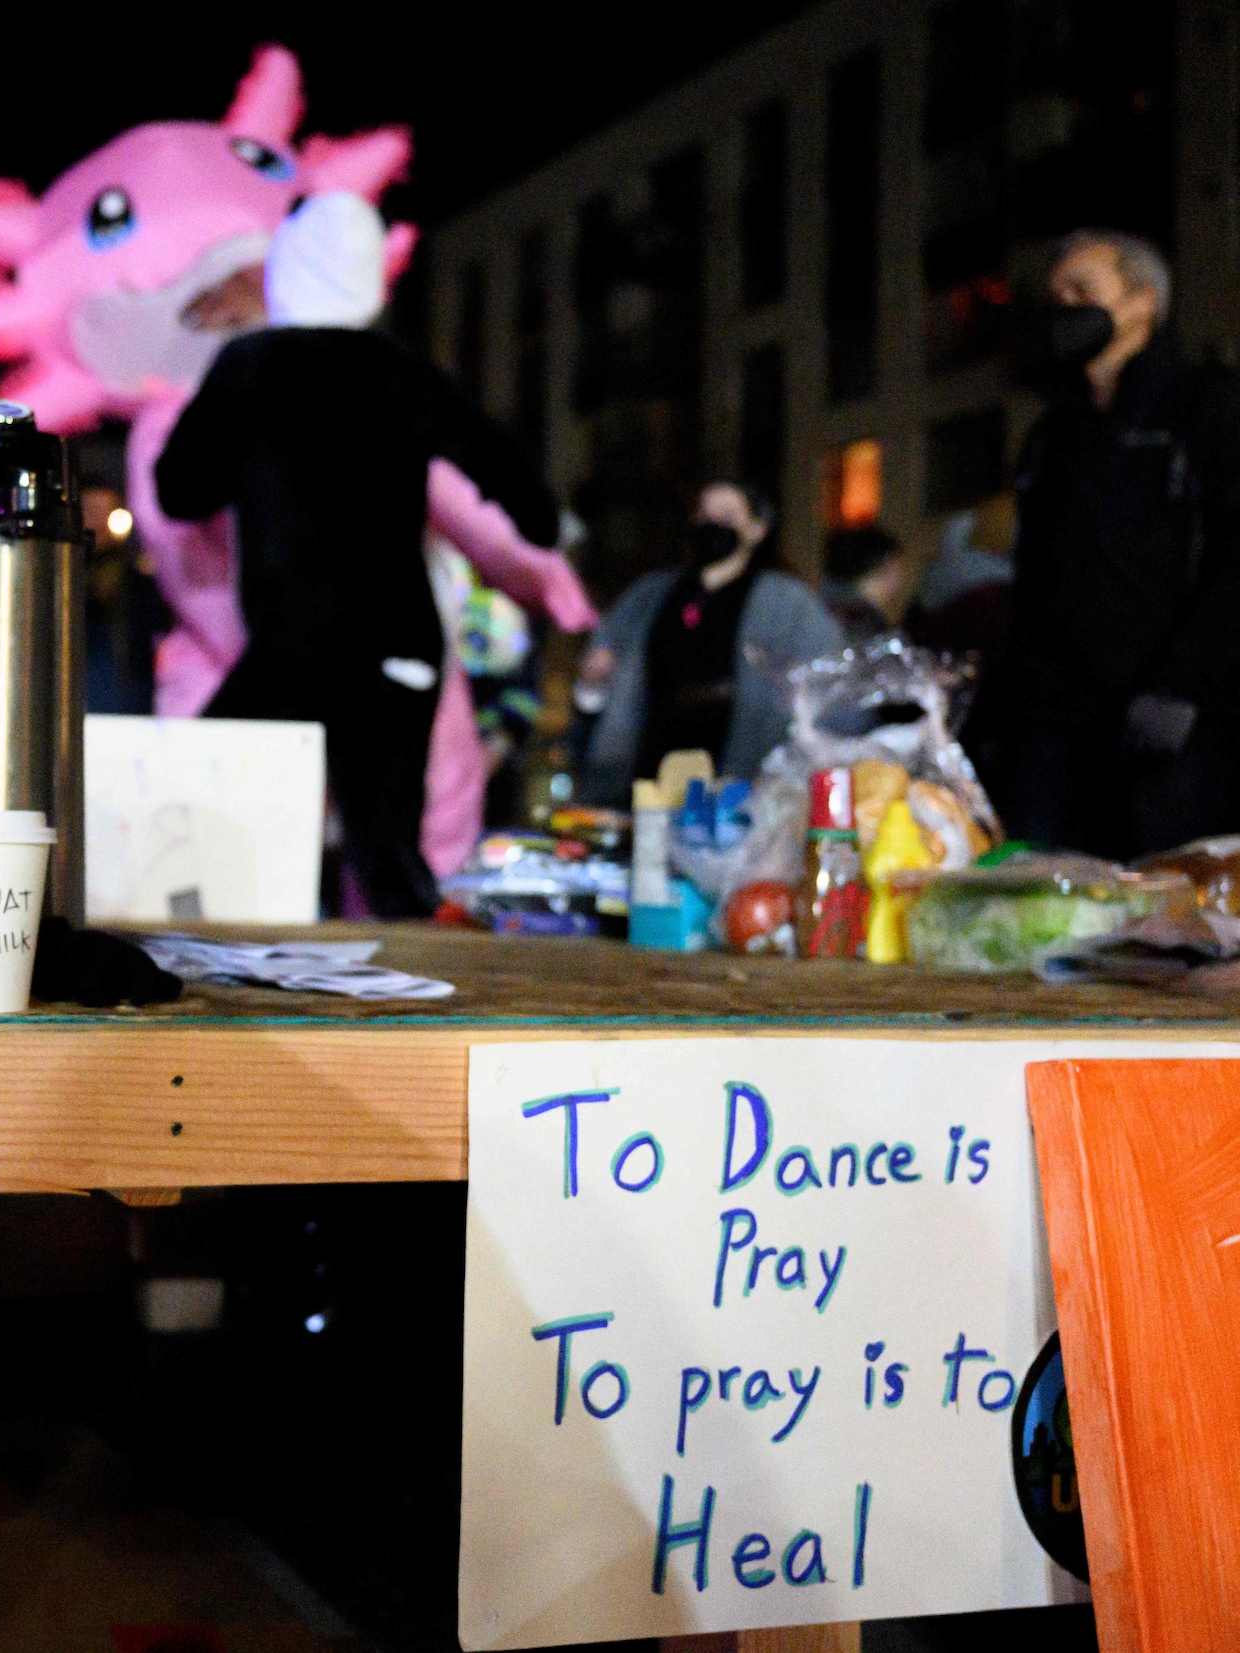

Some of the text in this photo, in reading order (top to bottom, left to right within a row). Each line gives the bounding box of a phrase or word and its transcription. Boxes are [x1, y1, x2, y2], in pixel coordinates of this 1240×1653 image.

[522, 1080, 992, 1199] To Dance is
[713, 1207, 847, 1315] Pray
[532, 1310, 1019, 1457] To pray is to
[650, 1473, 872, 1596] Heal
